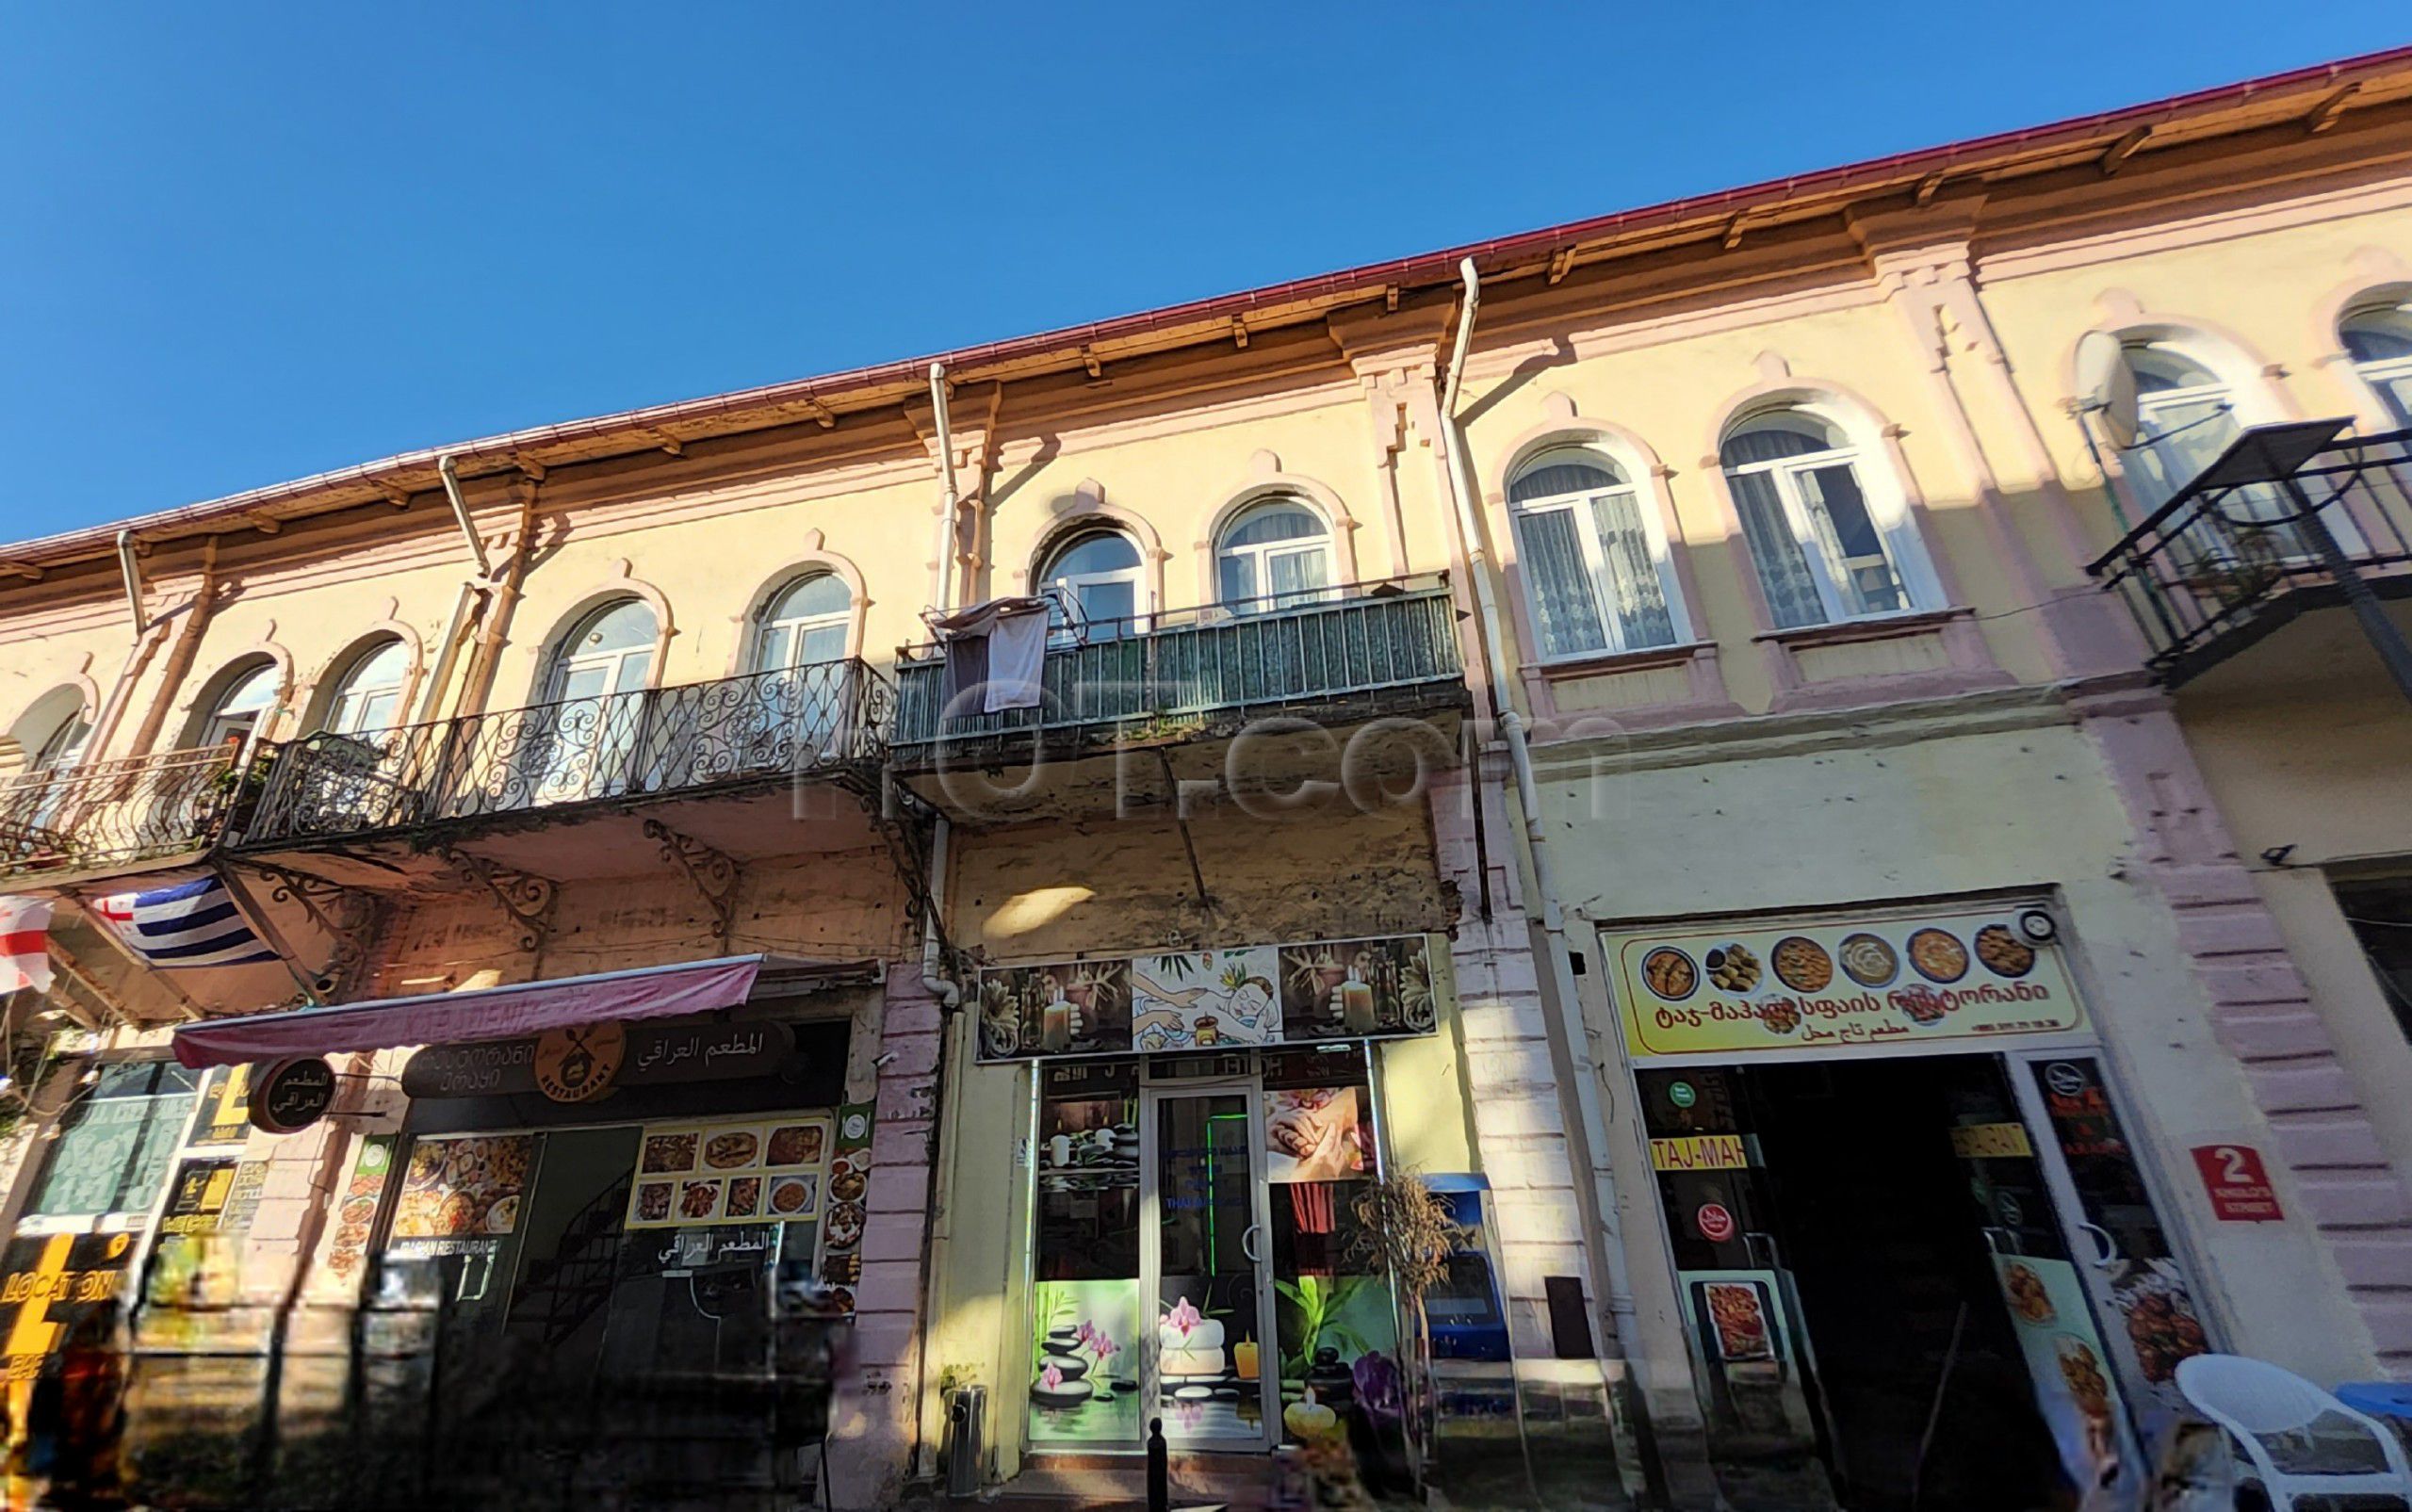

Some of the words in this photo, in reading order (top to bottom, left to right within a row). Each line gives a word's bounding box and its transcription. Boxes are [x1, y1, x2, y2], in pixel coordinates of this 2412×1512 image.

[1798, 991, 1882, 1019] სფაის
[1886, 981, 2050, 1011] რტორანი
[637, 1035, 700, 1072] العراقي
[705, 1032, 764, 1066] المطعم
[281, 1070, 329, 1091] المطعم
[271, 1092, 325, 1114] العراقي
[2214, 1146, 2255, 1183] 2
